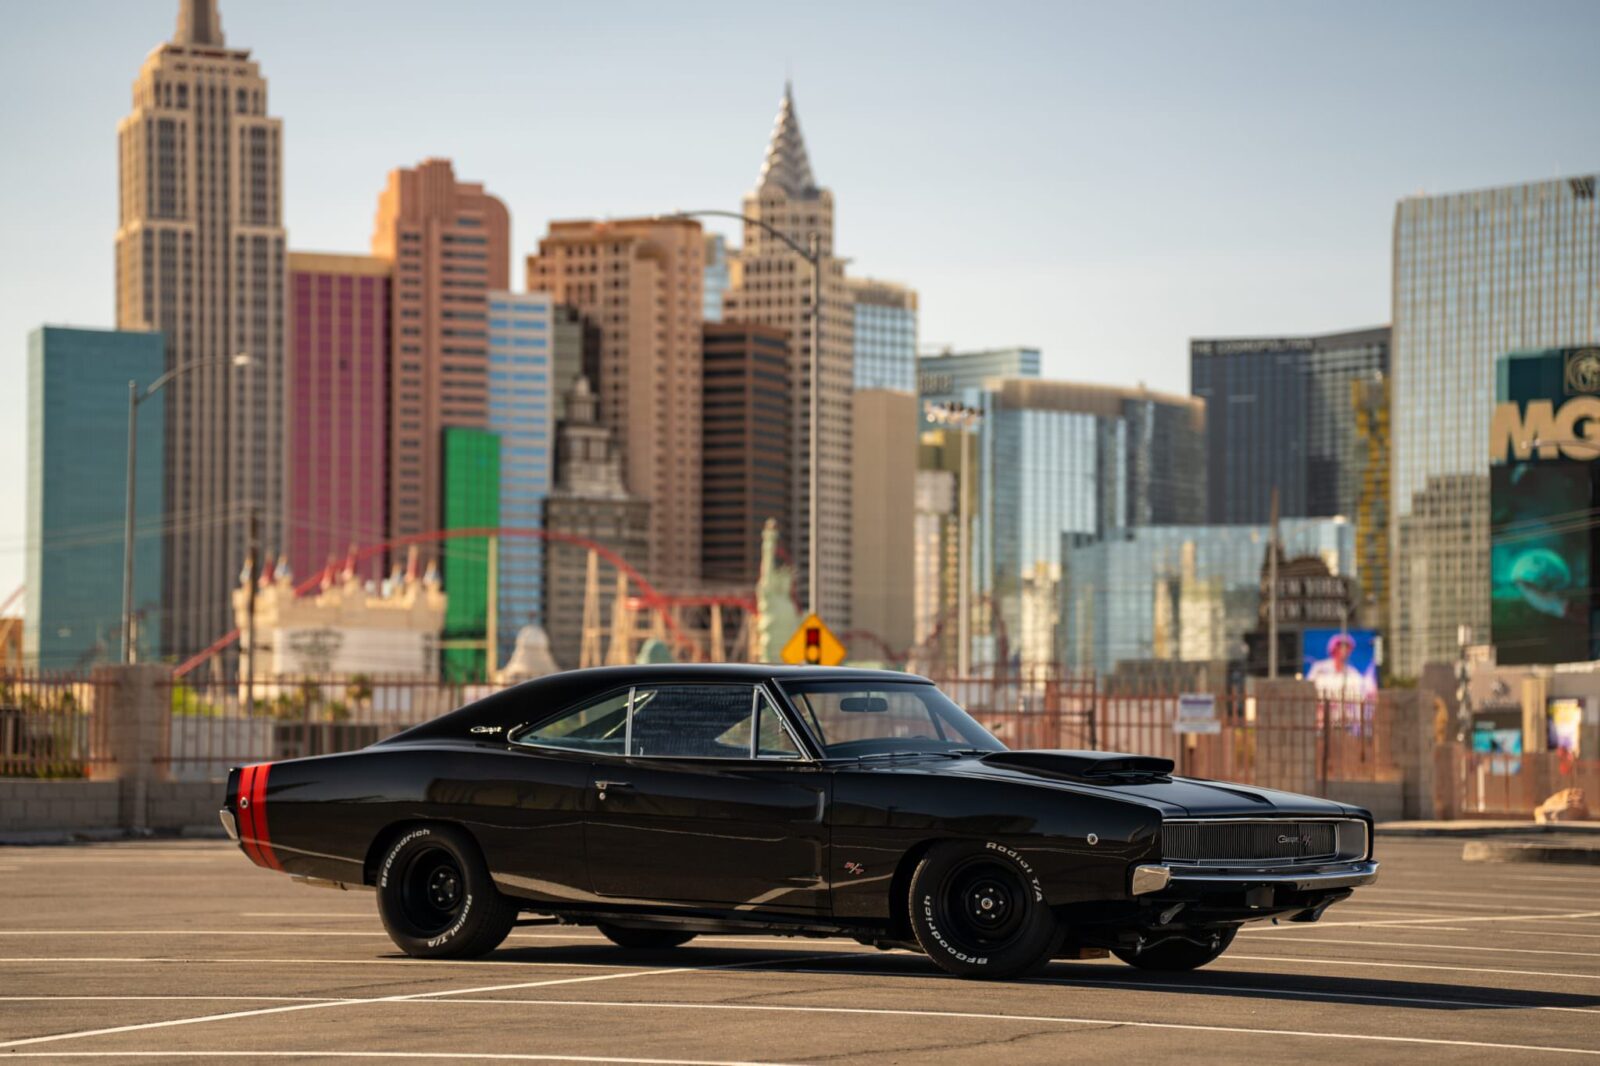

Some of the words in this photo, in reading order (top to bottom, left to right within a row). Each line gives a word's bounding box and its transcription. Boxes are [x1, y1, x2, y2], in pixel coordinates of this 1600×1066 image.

[381, 828, 431, 888] BFGoodrich
[986, 842, 1033, 873] Radial
[1032, 877, 1043, 902] T/A
[427, 937, 448, 947] T/A
[450, 894, 472, 936] Radial
[924, 895, 988, 965] BFGoodrich
